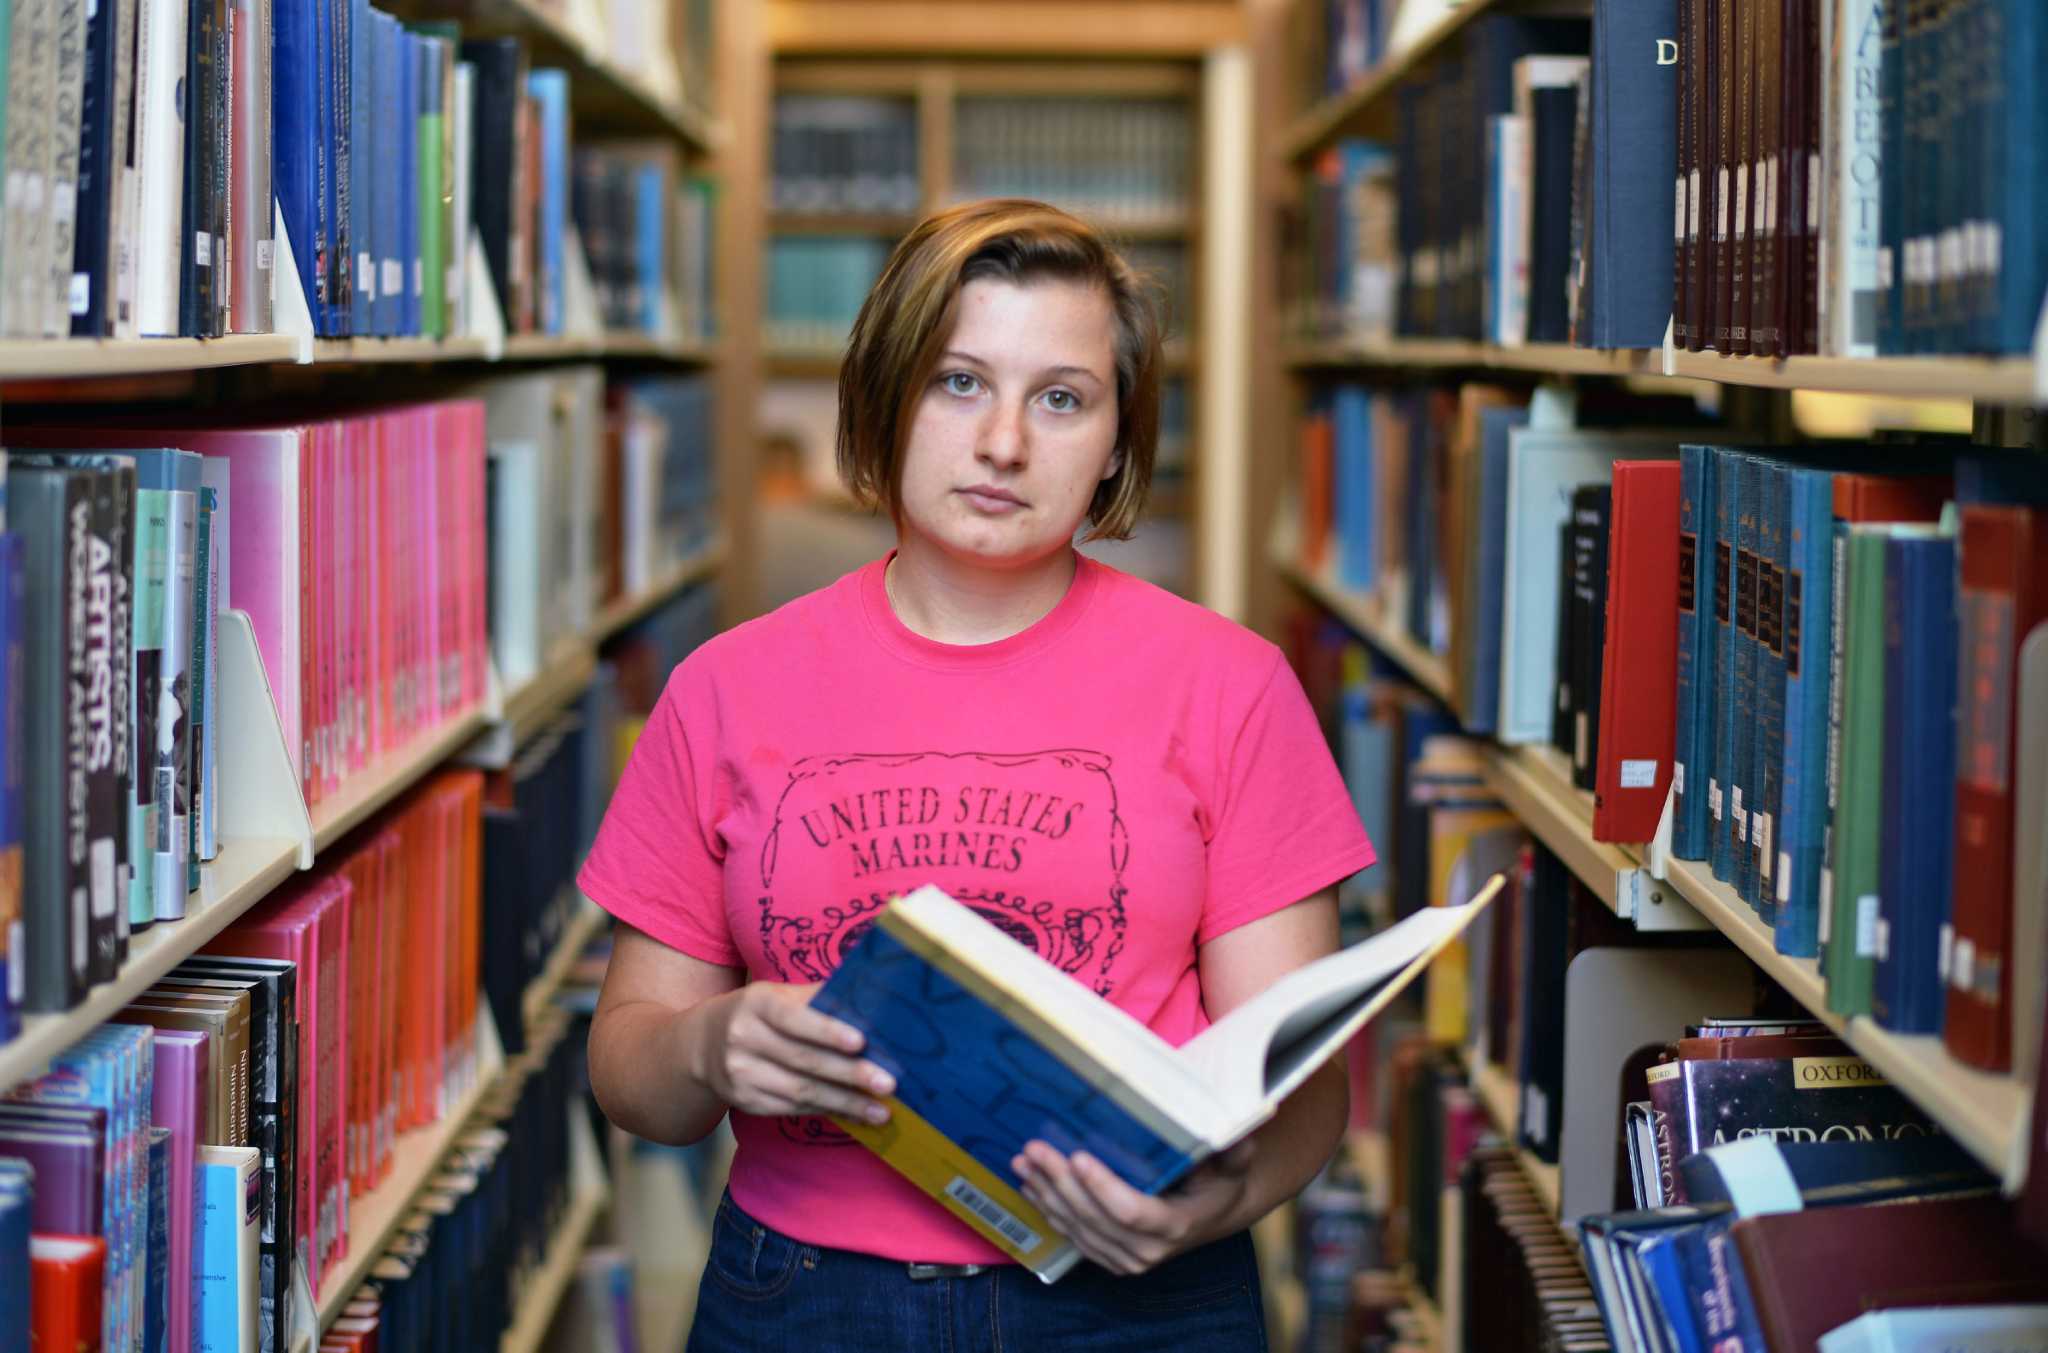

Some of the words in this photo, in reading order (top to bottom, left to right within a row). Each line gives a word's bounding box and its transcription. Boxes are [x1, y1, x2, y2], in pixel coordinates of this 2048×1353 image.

[86, 533, 112, 773] ARTISTS
[112, 572, 128, 776] ARTISTS
[800, 787, 940, 848] UNITED
[954, 787, 1084, 840] STATES
[850, 831, 1027, 878] MARINES
